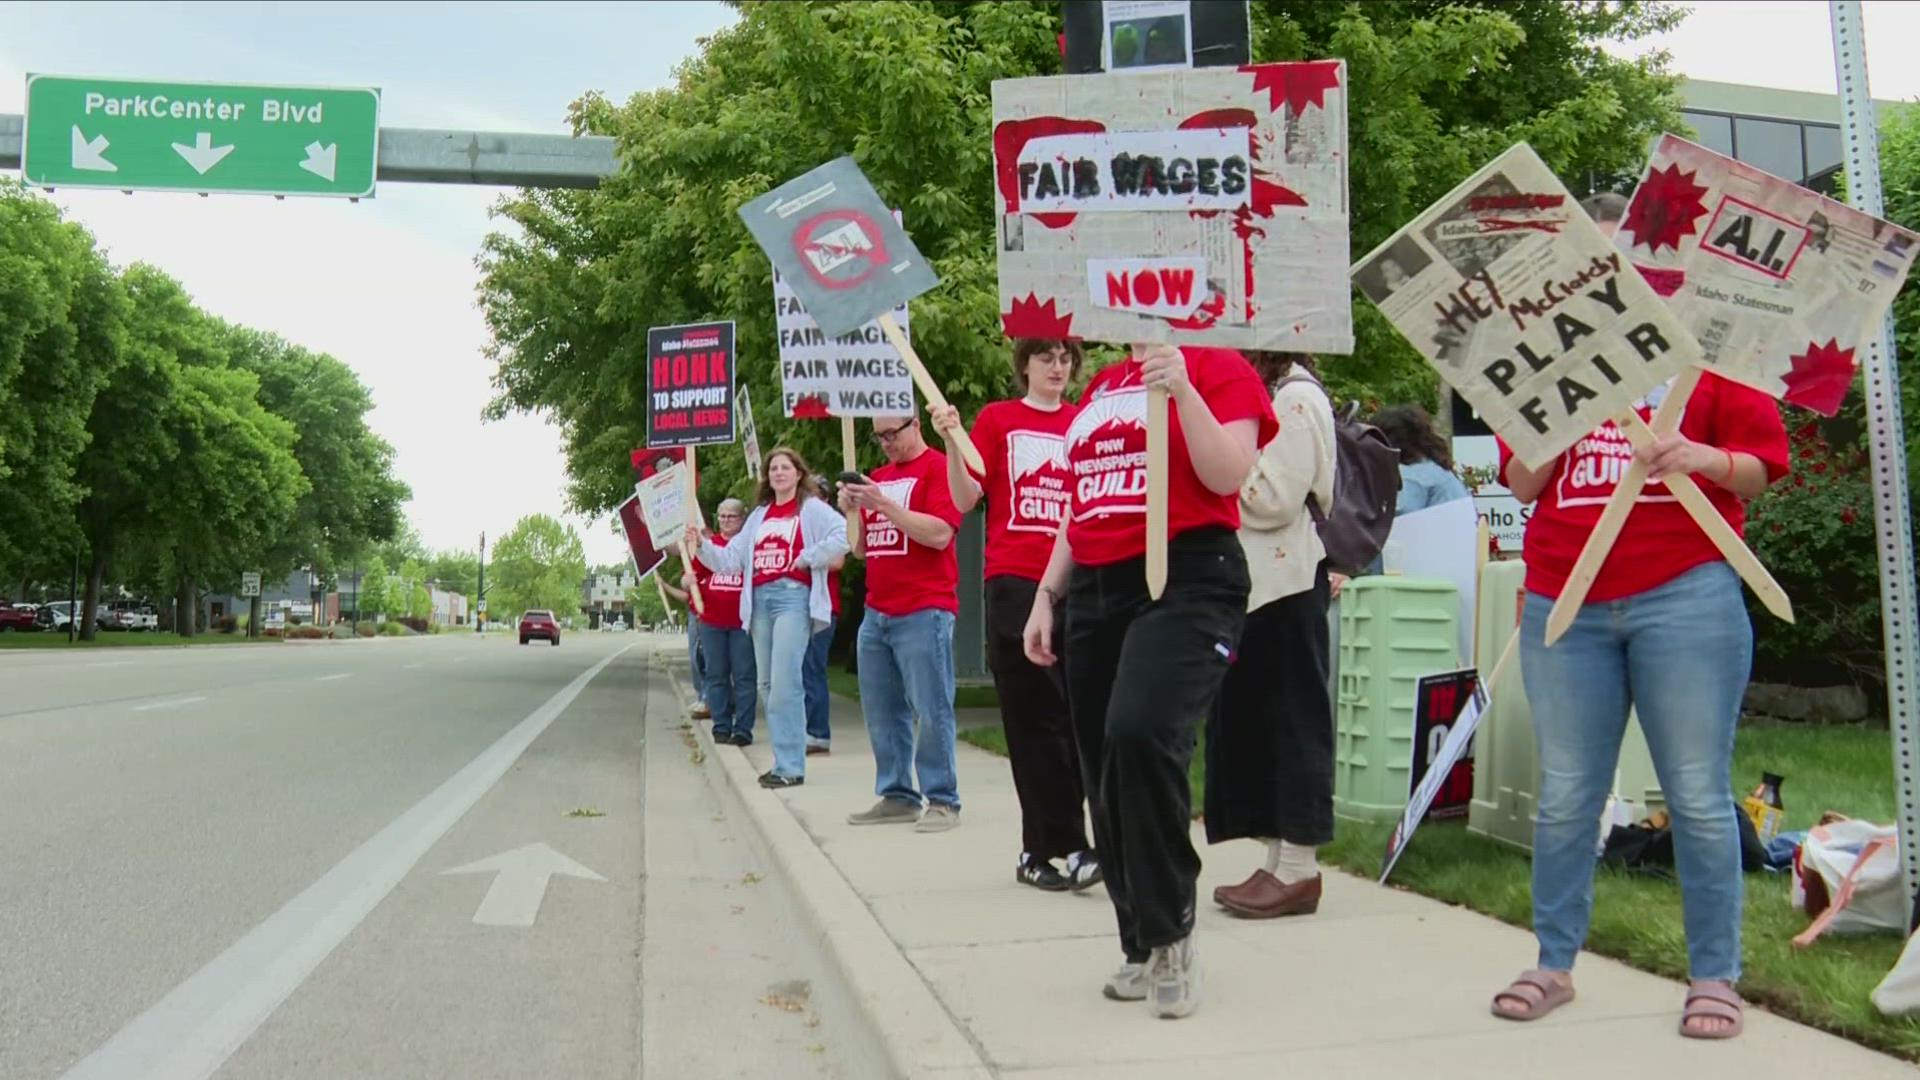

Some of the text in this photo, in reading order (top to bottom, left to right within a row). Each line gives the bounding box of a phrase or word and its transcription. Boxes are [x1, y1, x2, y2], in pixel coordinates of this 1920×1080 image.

[85, 92, 323, 123] ParkCenter Blvd
[1018, 151, 1247, 200] FAIR WAGES
[1712, 213, 1786, 273] A.I.
[1106, 268, 1195, 307] NOW
[1433, 267, 1506, 335] HEY
[1482, 276, 1628, 397] PLAY
[653, 351, 728, 390] HONK
[783, 358, 909, 379] FAIR WAGES
[1518, 322, 1672, 435] FAIR
[652, 386, 727, 411] TO SUPPORT
[838, 389, 912, 410] WAGES
[654, 407, 728, 431] LOCAL NEWS
[1095, 437, 1125, 455] PNW
[1077, 469, 1148, 504] GUILD
[1019, 498, 1062, 523] GUIL
